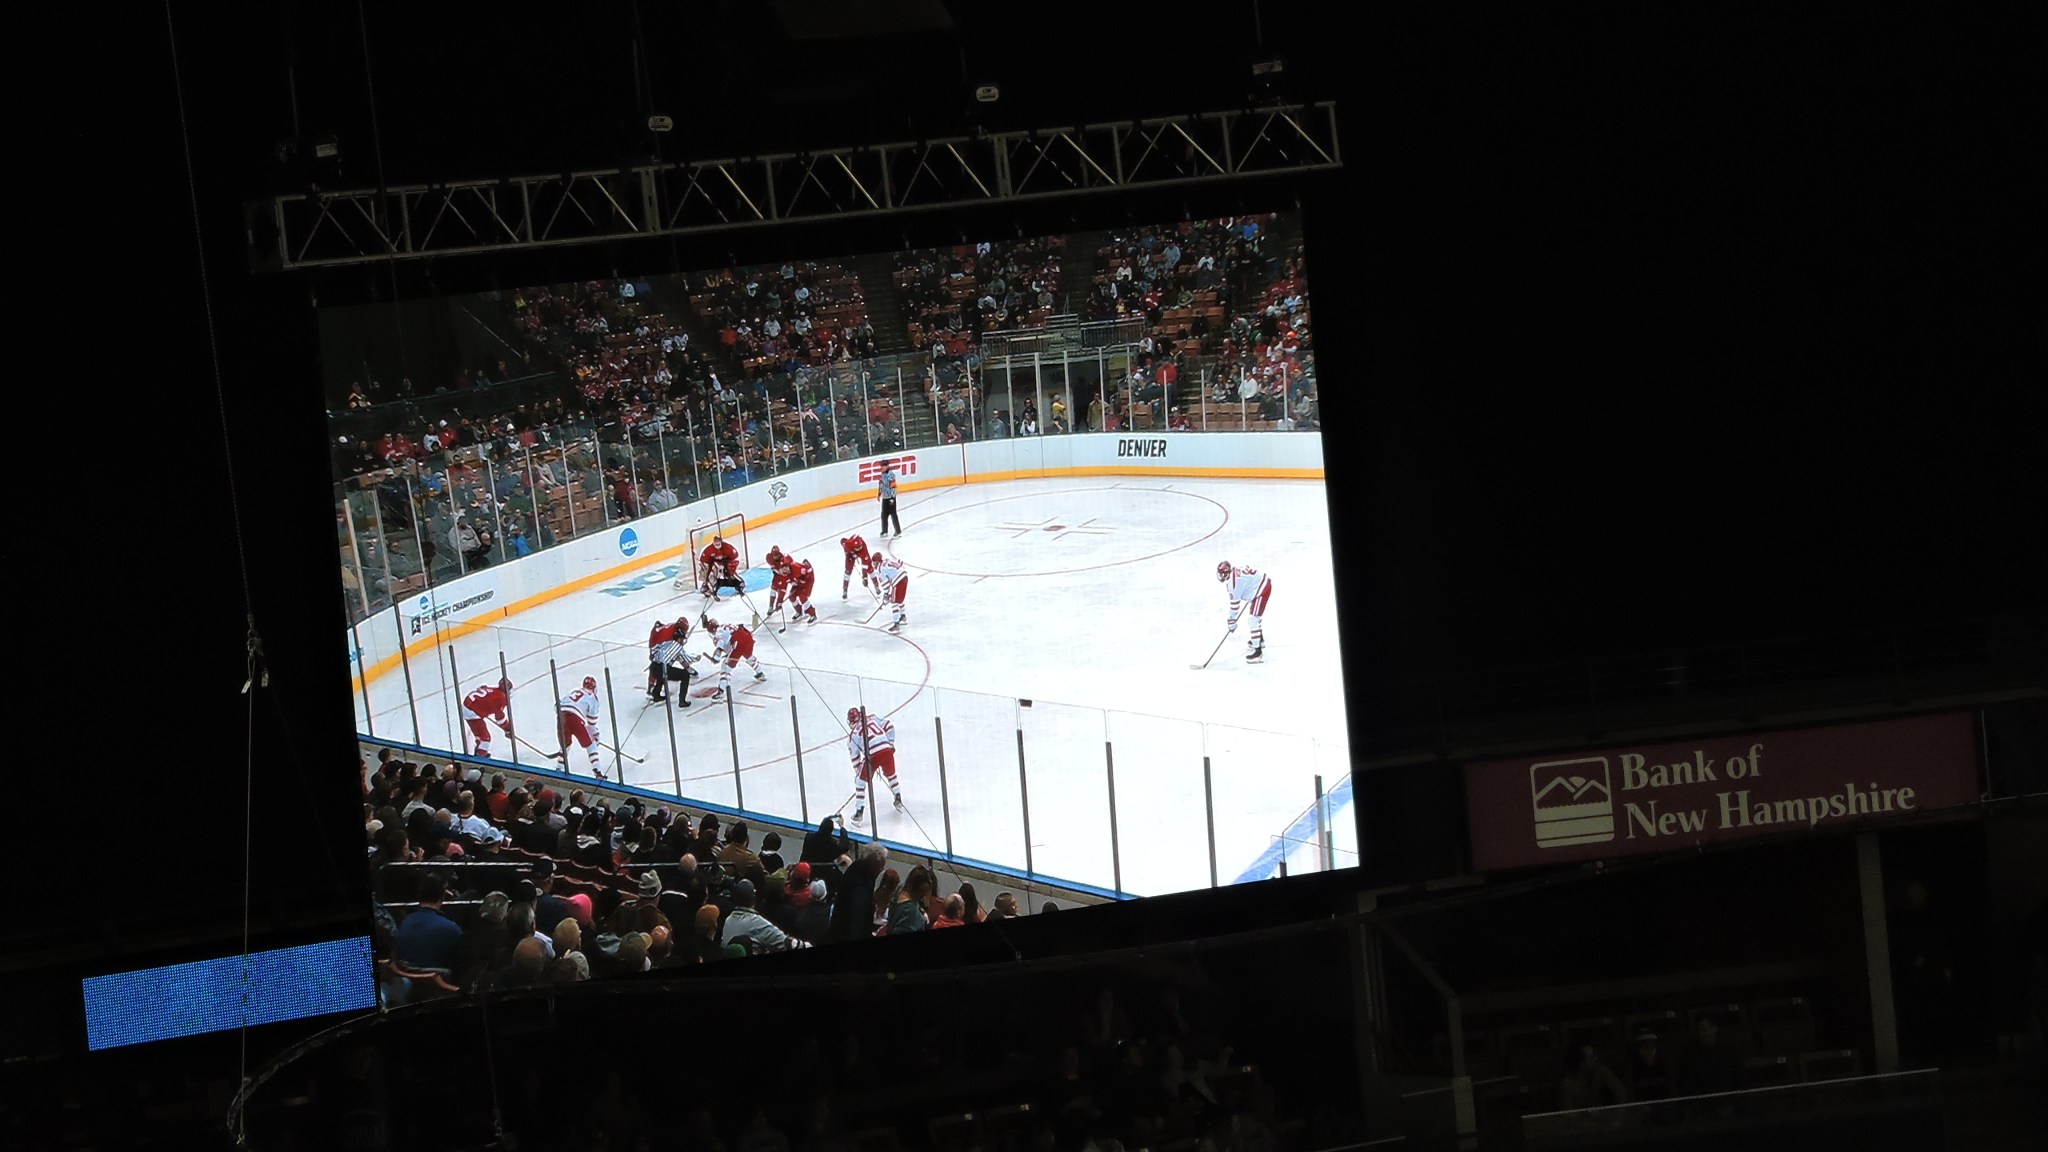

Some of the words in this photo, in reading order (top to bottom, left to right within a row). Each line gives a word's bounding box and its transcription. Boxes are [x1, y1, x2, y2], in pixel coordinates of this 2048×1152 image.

[1117, 438, 1168, 458] DENVER
[858, 455, 917, 484] ESPN
[1619, 750, 1718, 791] Bank
[1725, 744, 1763, 780] of
[1623, 800, 1709, 840] New
[1716, 782, 1916, 831] Hampshire
